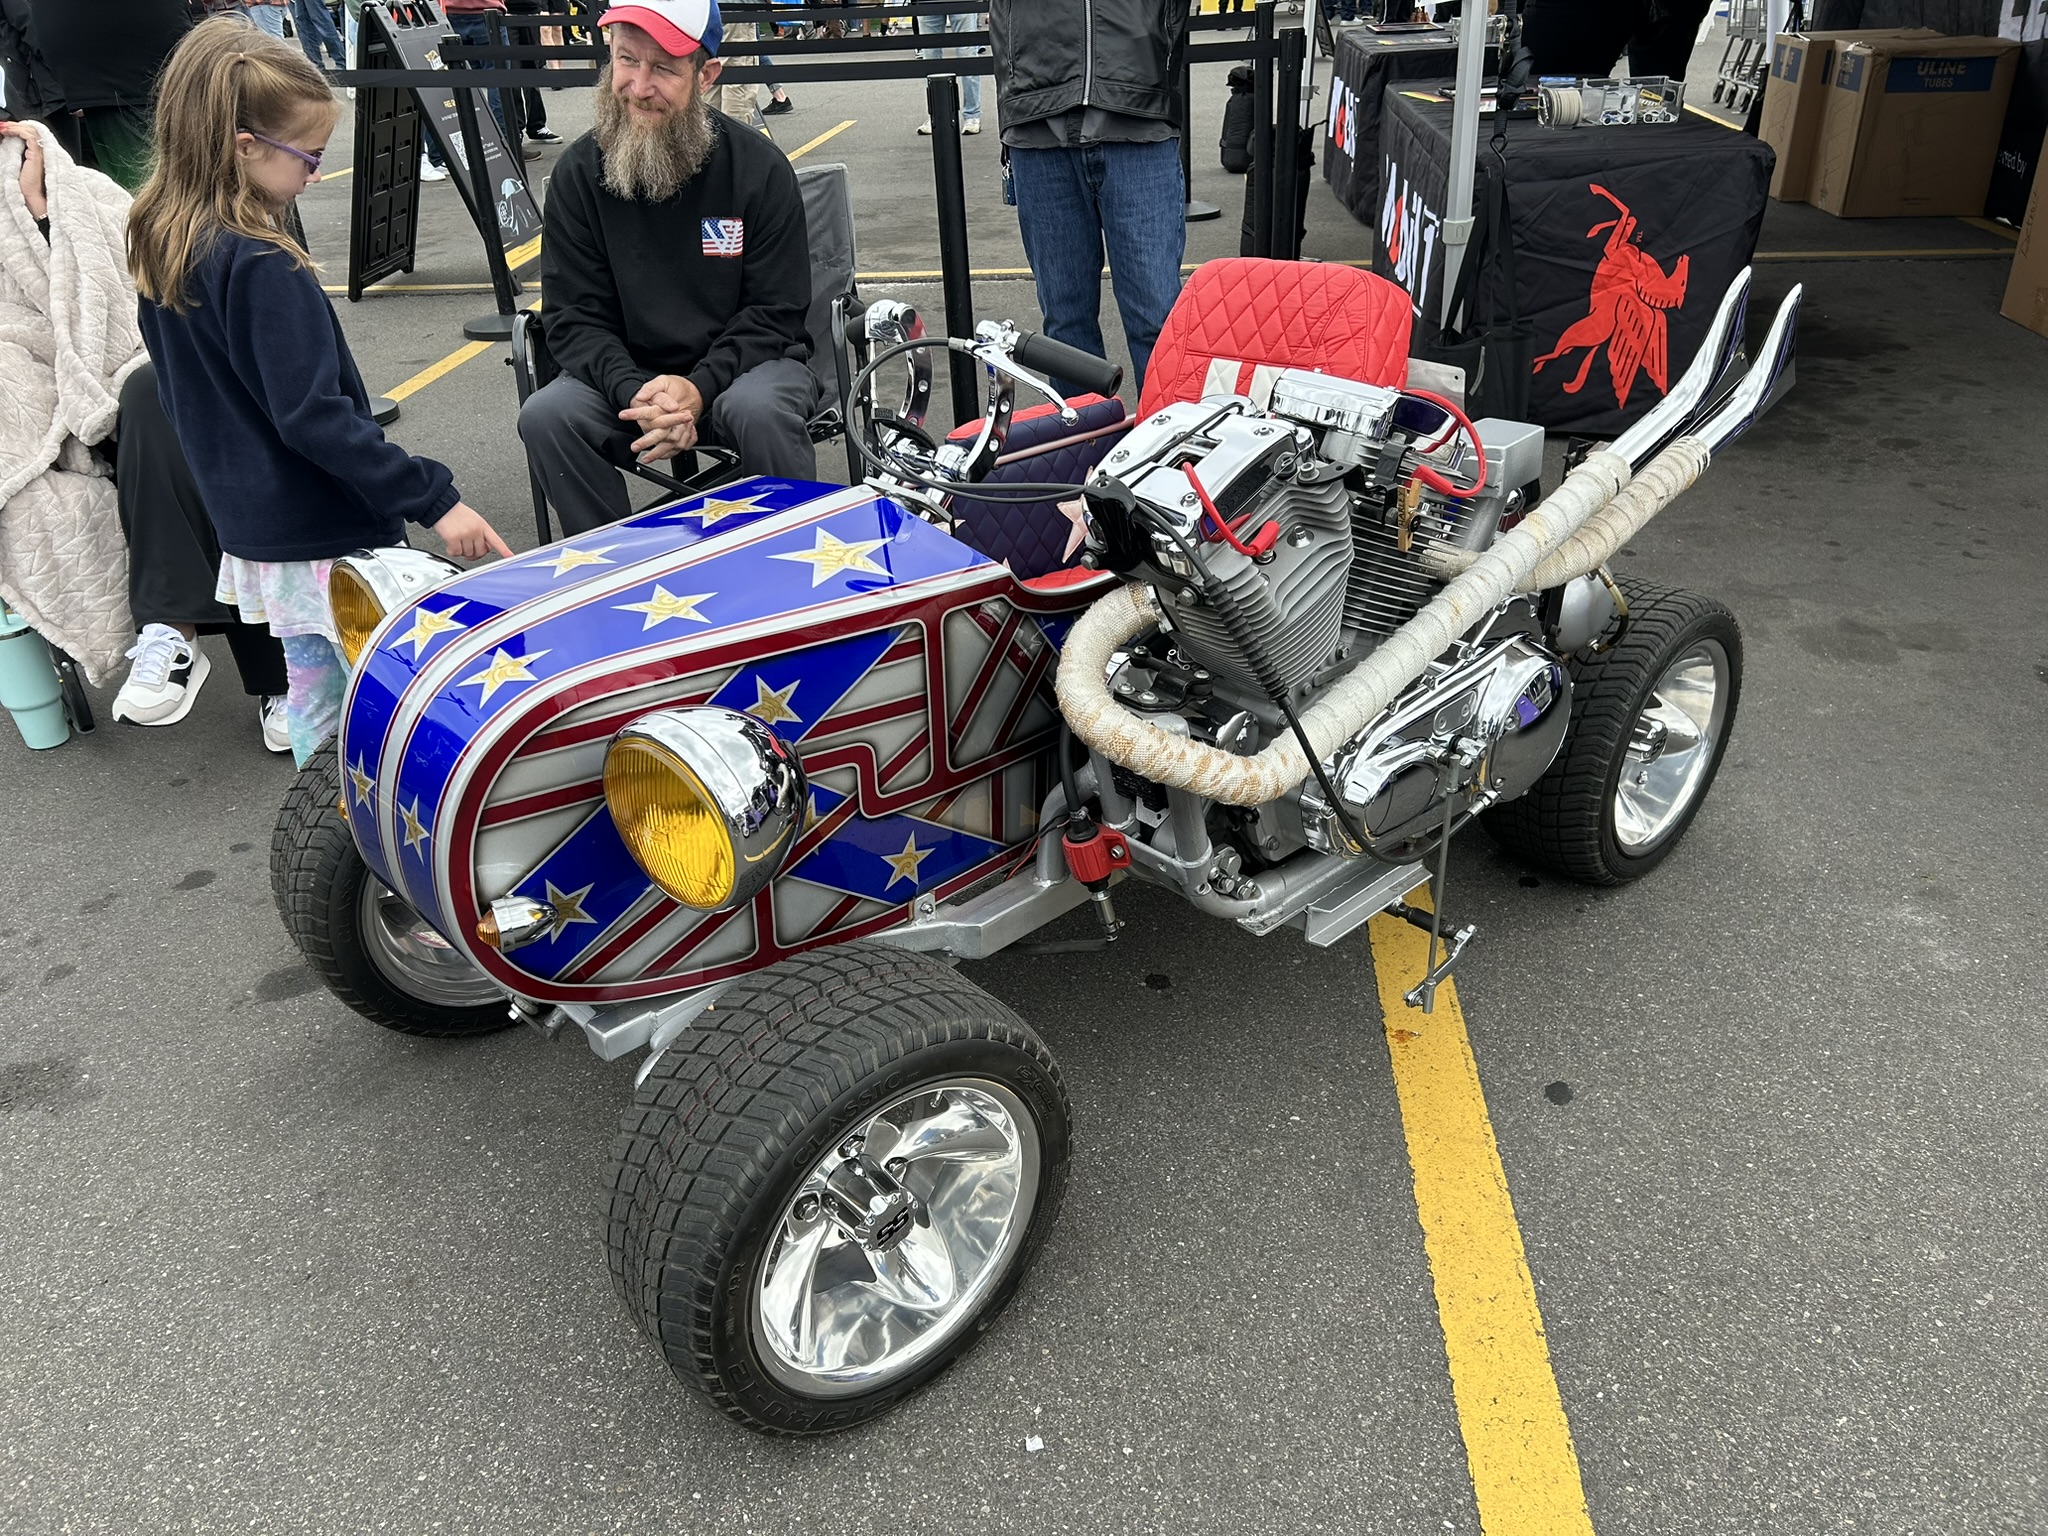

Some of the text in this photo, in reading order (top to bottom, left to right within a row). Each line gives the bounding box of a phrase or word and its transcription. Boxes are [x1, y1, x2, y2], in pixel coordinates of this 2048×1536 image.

[1917, 61, 1967, 76] ULINE
[1924, 78, 1954, 88] TUBES
[1397, 490, 1406, 528] HARLEY
[793, 1072, 902, 1168] CLASSIC
